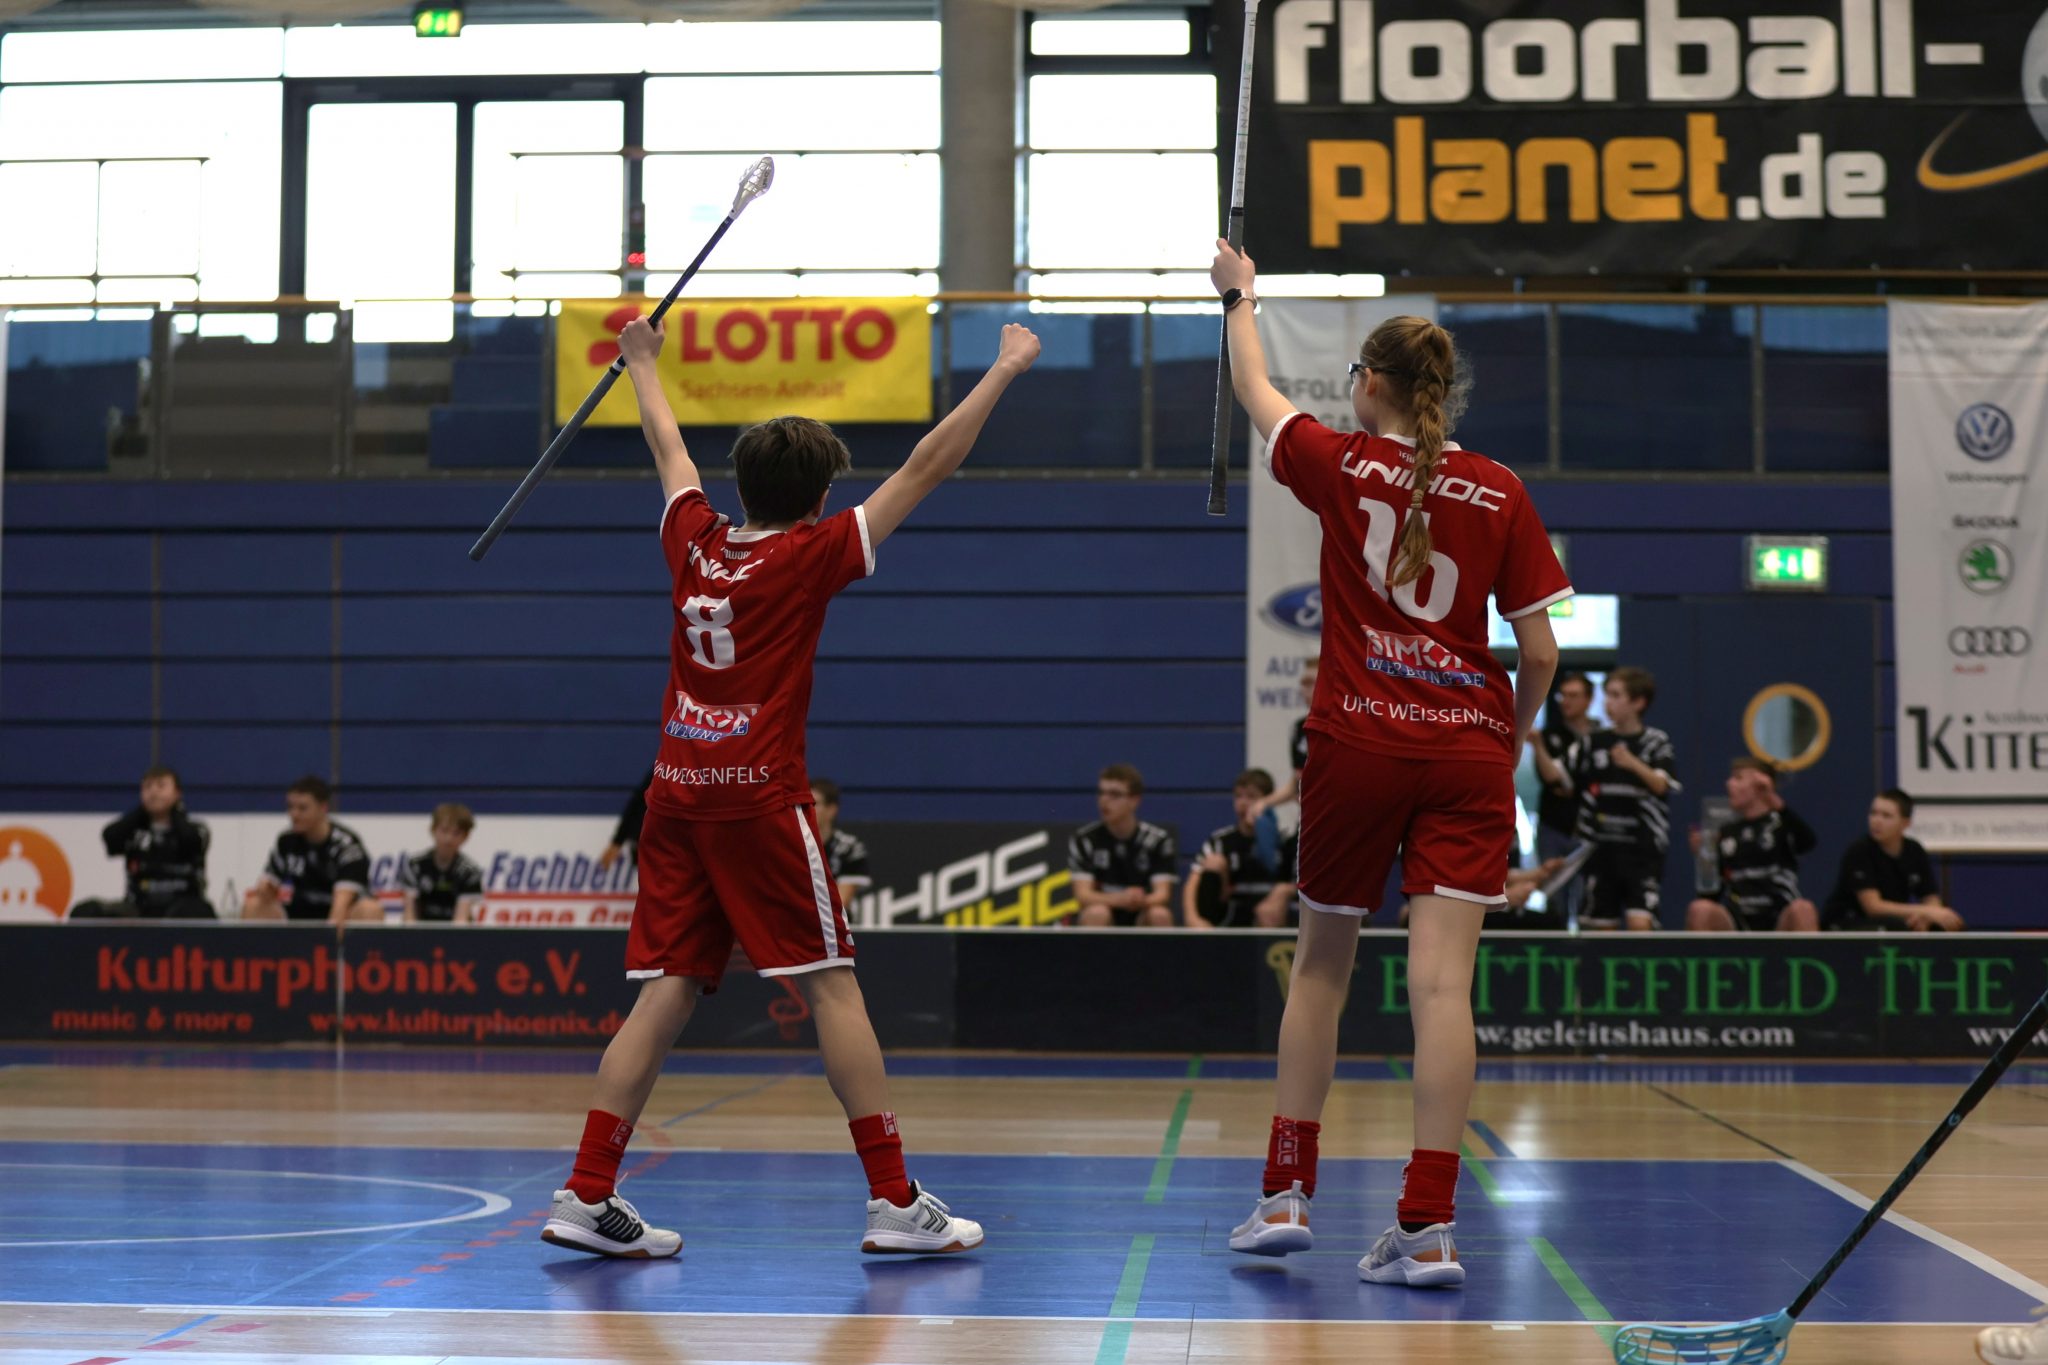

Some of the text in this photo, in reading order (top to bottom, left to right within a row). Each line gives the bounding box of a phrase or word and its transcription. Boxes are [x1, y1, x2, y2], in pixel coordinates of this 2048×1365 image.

[1273, 0, 1984, 104] floorball-
[1307, 113, 1886, 249] planet.de
[680, 308, 897, 363] LOTTO
[680, 378, 846, 400] Sachsen-Anhalt
[1340, 451, 1507, 512] UNIHOC
[1358, 496, 1459, 623] 16
[681, 594, 736, 670] 8
[1266, 656, 1305, 676] AU
[1343, 694, 1384, 716] UHC
[851, 831, 1049, 928] IHOC
[98, 946, 588, 1007] Kulturphönix e.V.
[1379, 945, 2015, 1015] BTTLEFIELD THE
[52, 1007, 253, 1031] music & more
[1474, 1020, 1796, 1050] w.geleitshaus.com
